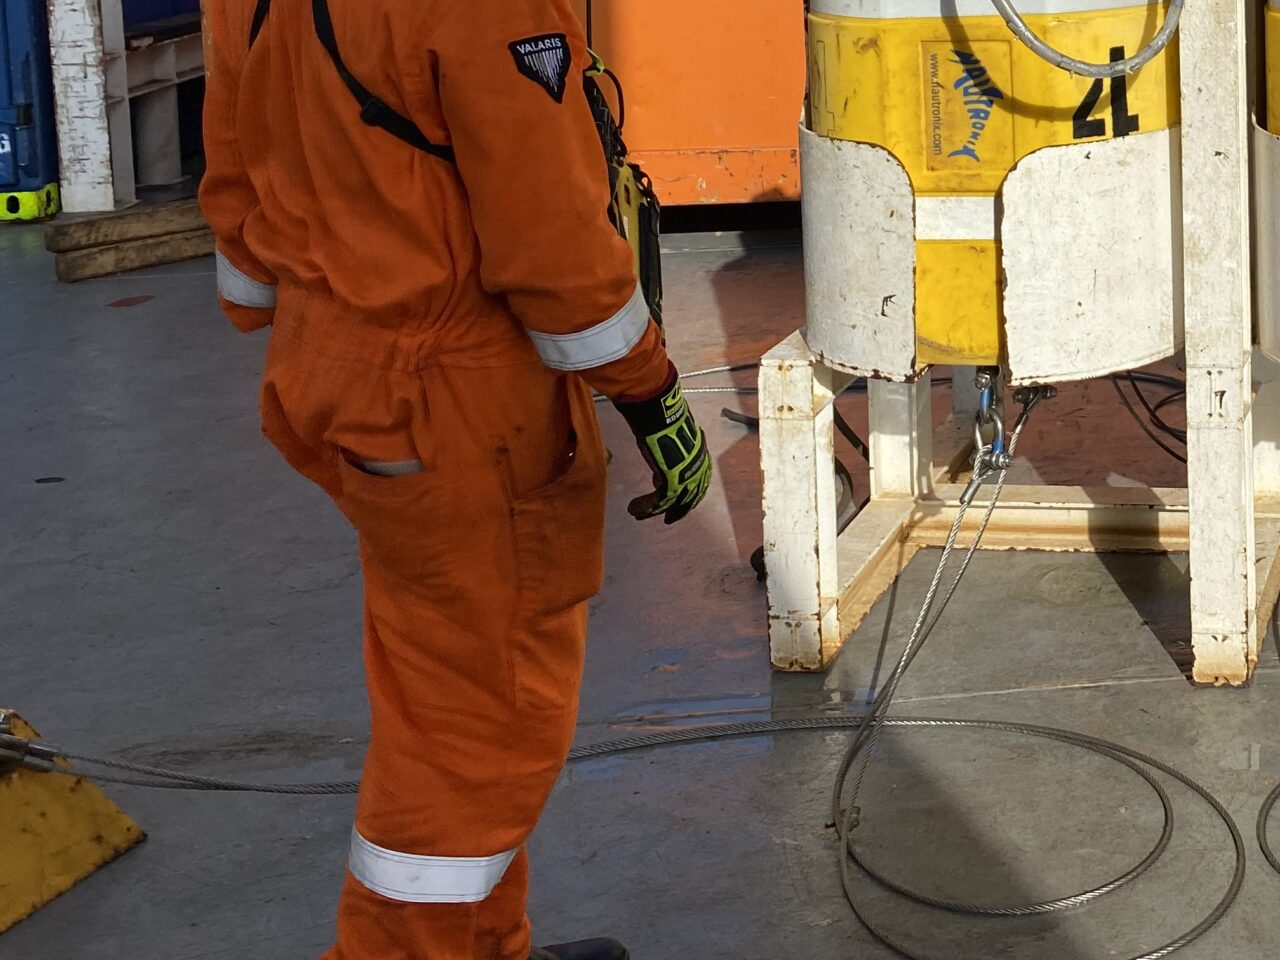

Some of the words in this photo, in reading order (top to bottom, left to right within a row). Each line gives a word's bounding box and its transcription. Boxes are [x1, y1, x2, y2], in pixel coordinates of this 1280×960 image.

[516, 38, 562, 54] VALARIS
[1072, 45, 1140, 139] 4
[929, 53, 942, 156] www.nautronix.com
